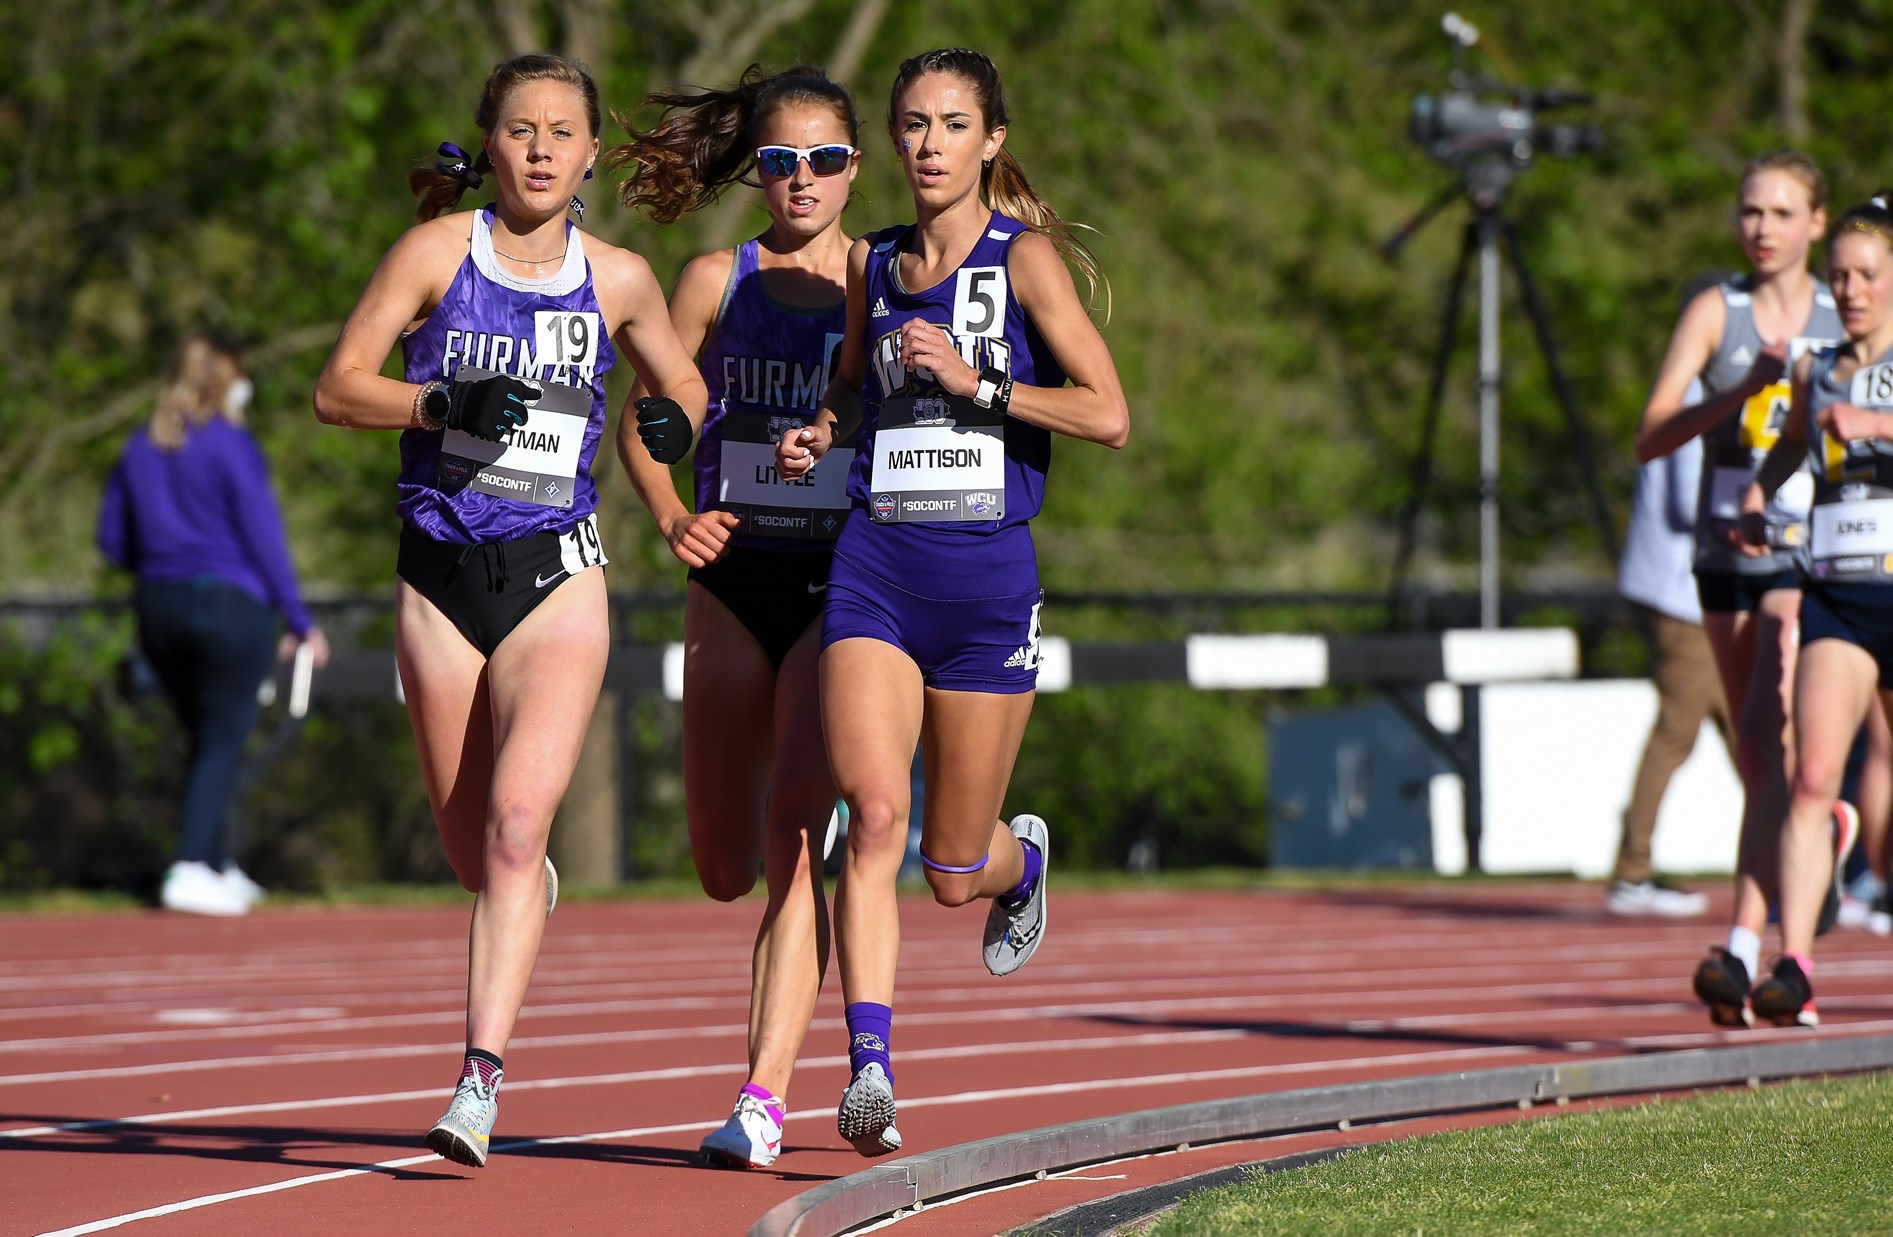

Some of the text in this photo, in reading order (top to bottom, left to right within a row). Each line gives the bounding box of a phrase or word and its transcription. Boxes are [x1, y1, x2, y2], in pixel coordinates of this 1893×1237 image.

[966, 271, 996, 333] 5
[547, 315, 589, 363] 19
[872, 330, 1009, 399] WU
[888, 448, 982, 470] MATTISON
[477, 472, 532, 492] #SOCONTF
[902, 500, 957, 511] #SOCONTF
[965, 492, 997, 507] WCU
[753, 515, 808, 528] #SOCONTF
[569, 519, 601, 568] 19
